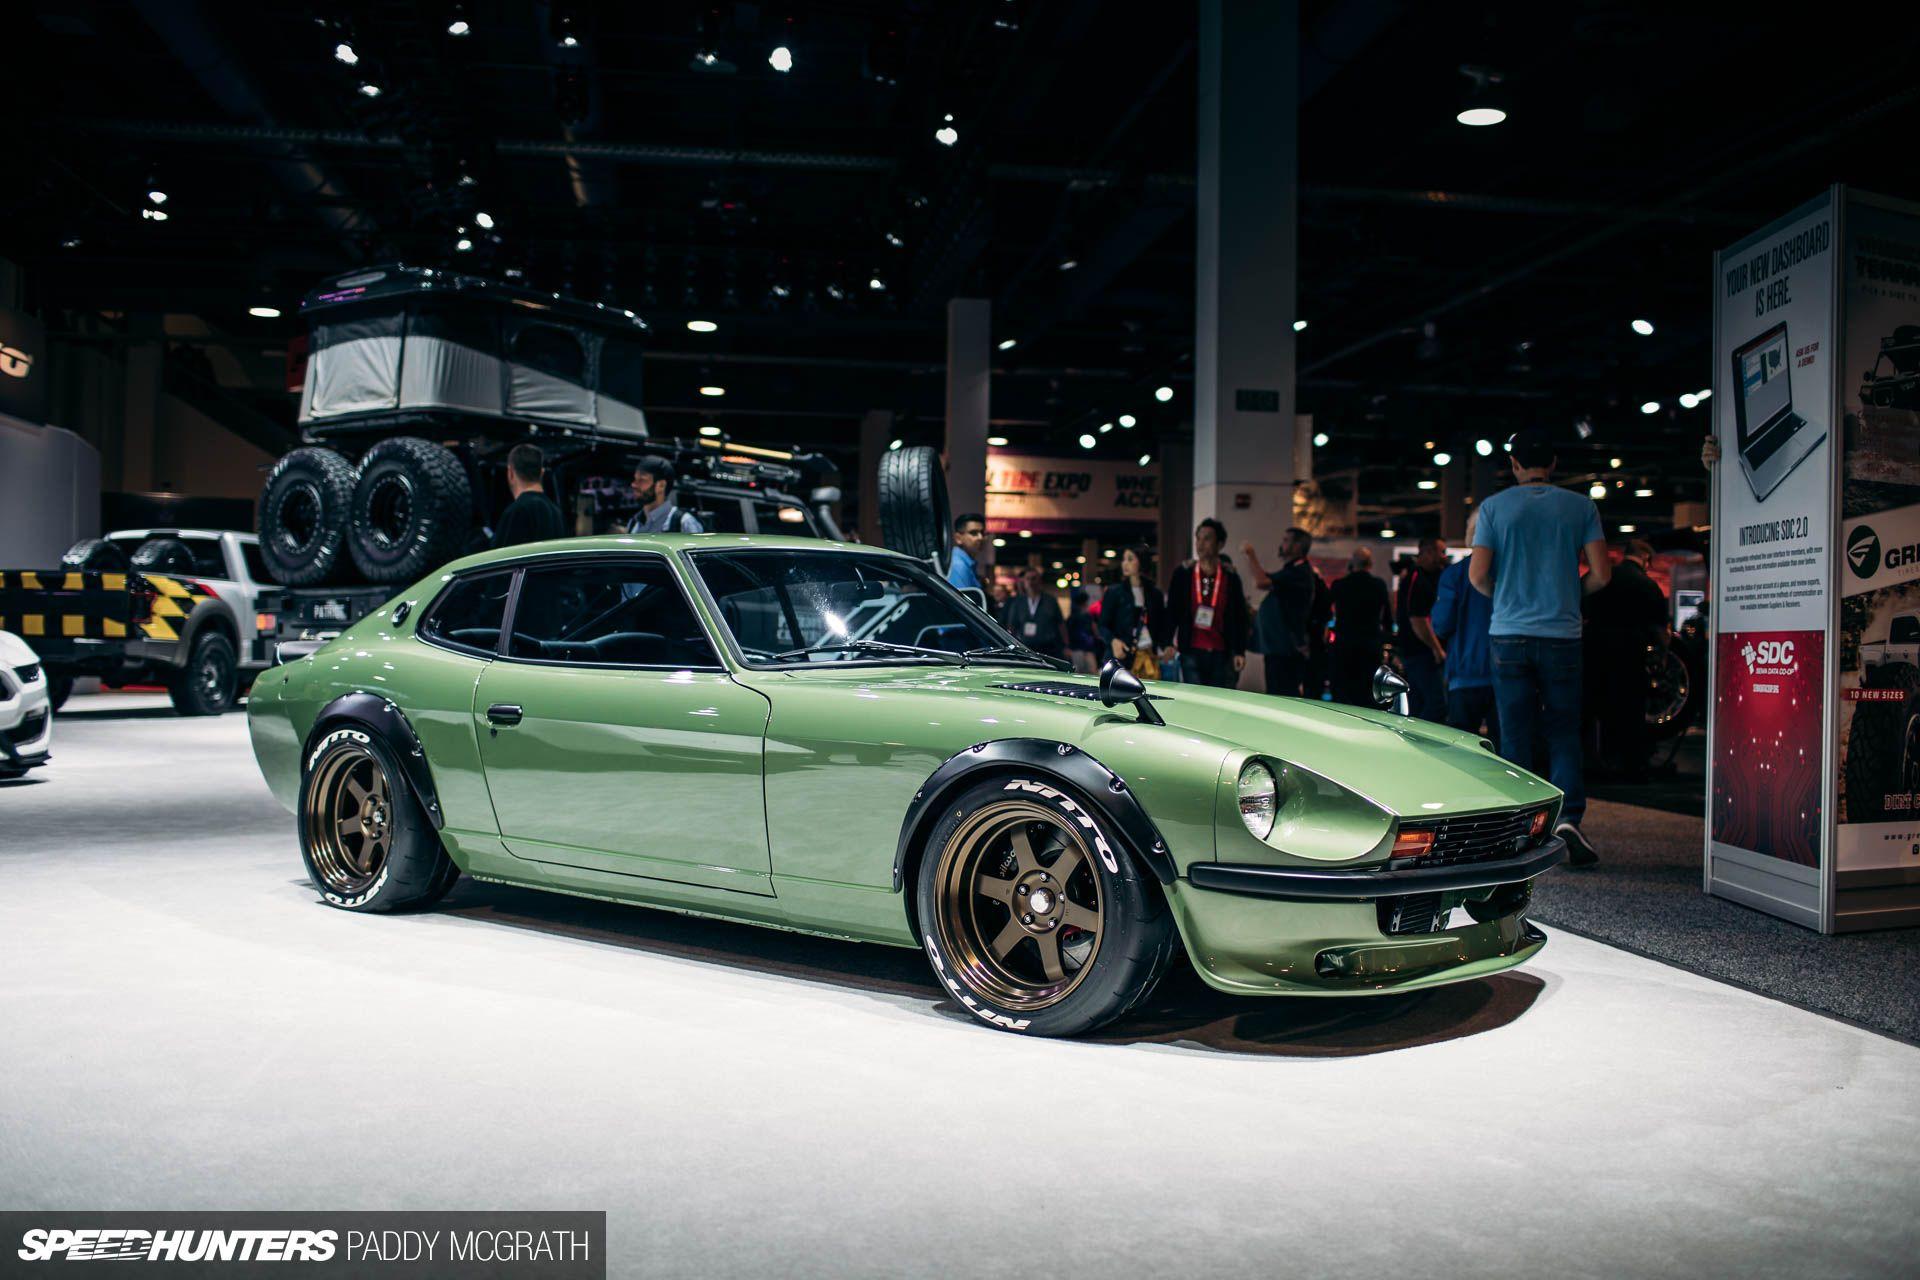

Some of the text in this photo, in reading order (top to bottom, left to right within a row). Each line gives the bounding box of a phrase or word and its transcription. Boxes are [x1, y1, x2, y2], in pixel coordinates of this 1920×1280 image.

[1726, 263, 1748, 298] YOUR
[1750, 251, 1770, 287] NEW
[1772, 220, 1830, 276] DASHBOARD
[1756, 276, 1792, 318] IS HERE.
[1044, 472, 1092, 492] EXPO
[1739, 516, 1808, 546] INTRODUCING SDC 2.0
[1756, 640, 1794, 665] SDC
[1850, 690, 1904, 700] 10 NEW SIZES
[309, 730, 370, 772] NITTO
[1004, 779, 1118, 874] NITTO
[325, 866, 388, 908] NITTO
[926, 935, 1032, 1030] NITTO
